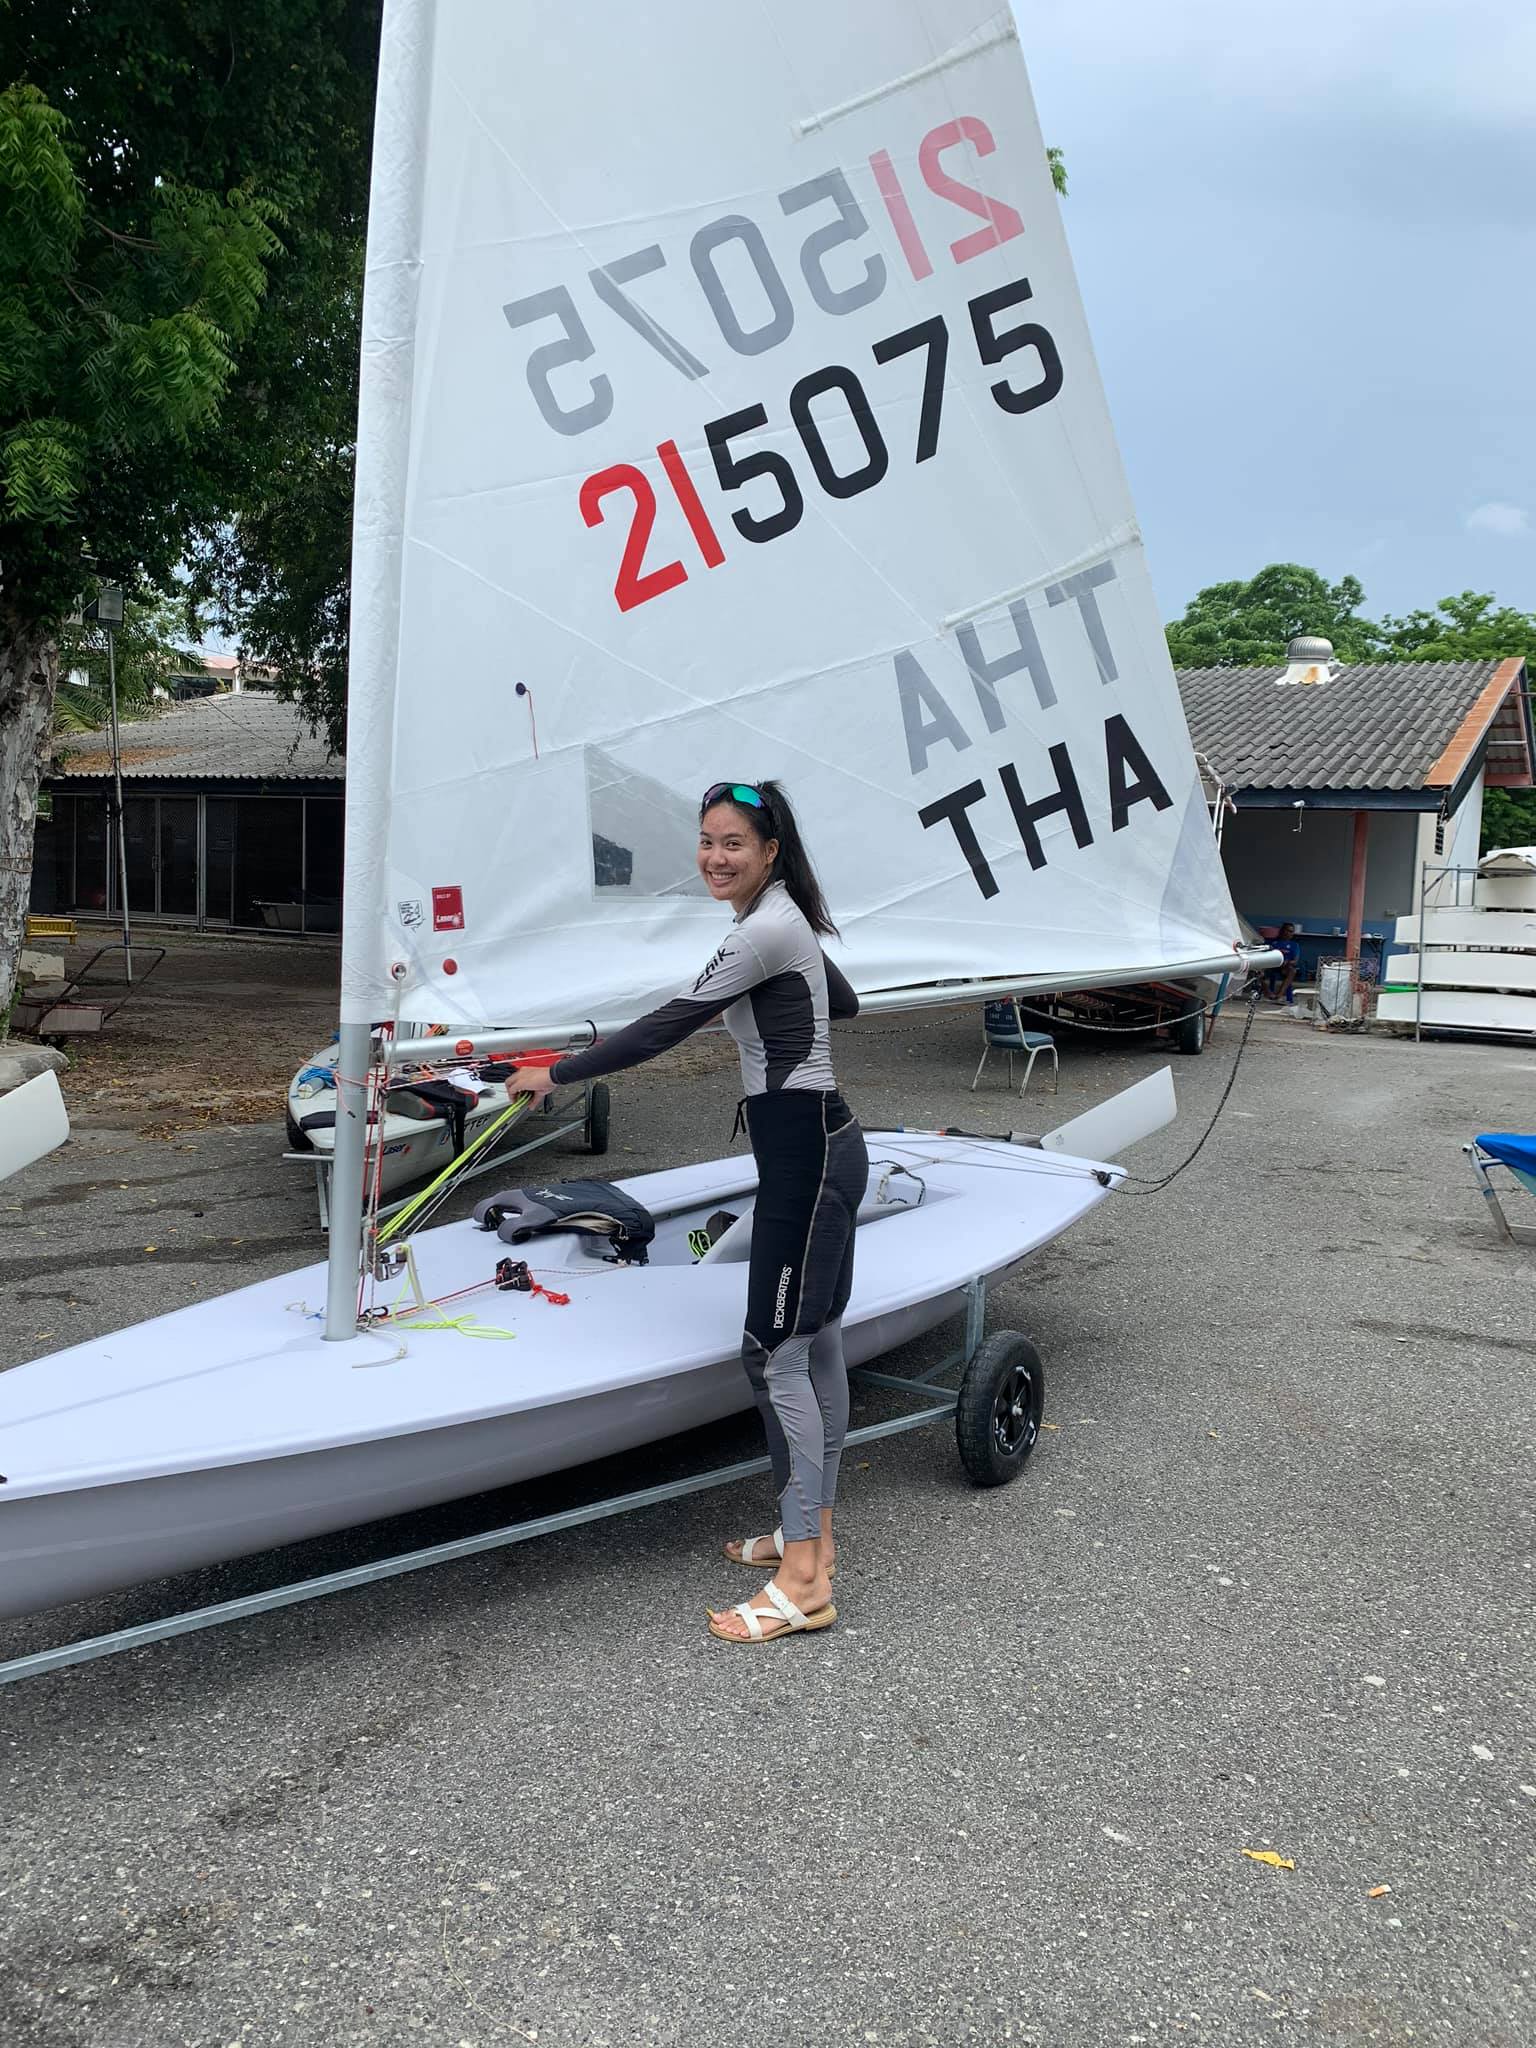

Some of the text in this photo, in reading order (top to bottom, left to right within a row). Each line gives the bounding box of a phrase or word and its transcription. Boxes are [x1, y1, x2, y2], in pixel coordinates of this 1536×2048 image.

[579, 277, 1064, 613] 215075
[917, 713, 1174, 900] THA
[773, 1266, 793, 1329] DECKBEATERS
